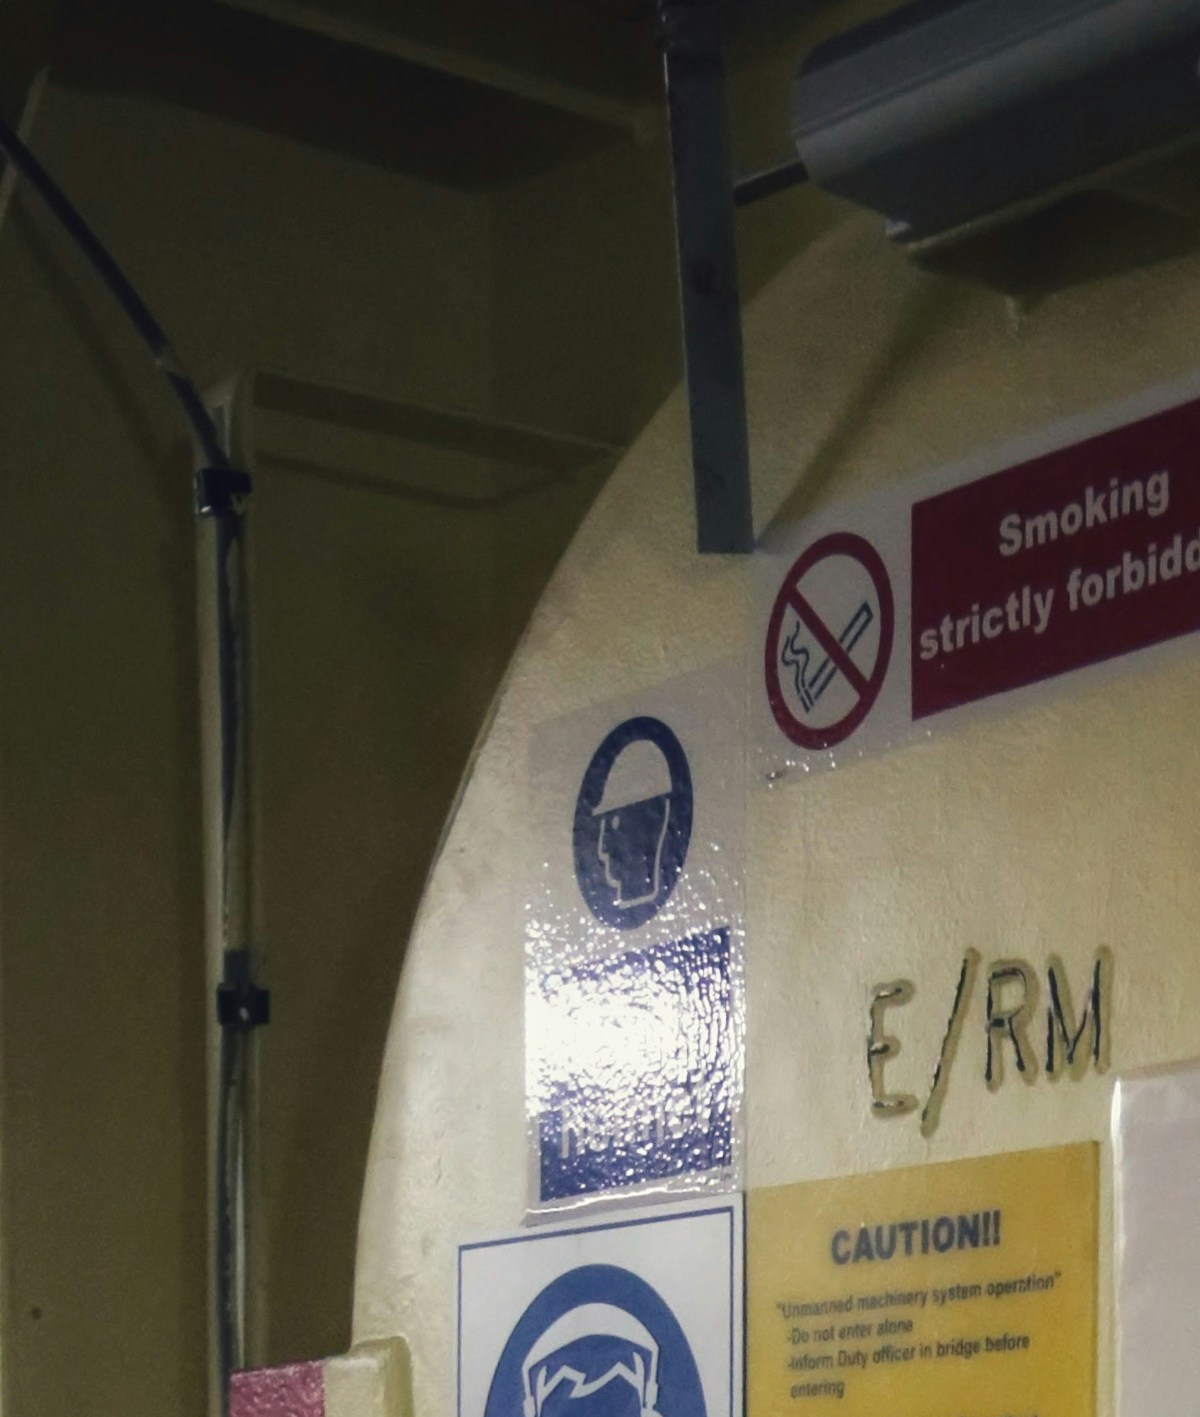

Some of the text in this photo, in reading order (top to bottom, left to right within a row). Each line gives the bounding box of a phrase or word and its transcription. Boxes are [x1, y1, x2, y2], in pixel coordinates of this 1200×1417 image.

[998, 469, 1170, 557] Smoking
[918, 584, 1055, 660] strictly
[868, 947, 1115, 1138] E/RM
[830, 1209, 1002, 1266] CAUTION!!
[857, 1288, 928, 1308] machinery
[932, 1283, 982, 1305] system
[813, 1325, 835, 1342] not
[838, 1322, 874, 1340] enter
[876, 1317, 914, 1337] alone
[837, 1350, 868, 1369] Duty
[872, 1343, 917, 1365] officer
[919, 1342, 933, 1358] in
[936, 1338, 981, 1359] bridge
[985, 1332, 1031, 1353] before
[790, 1380, 846, 1400] entering
